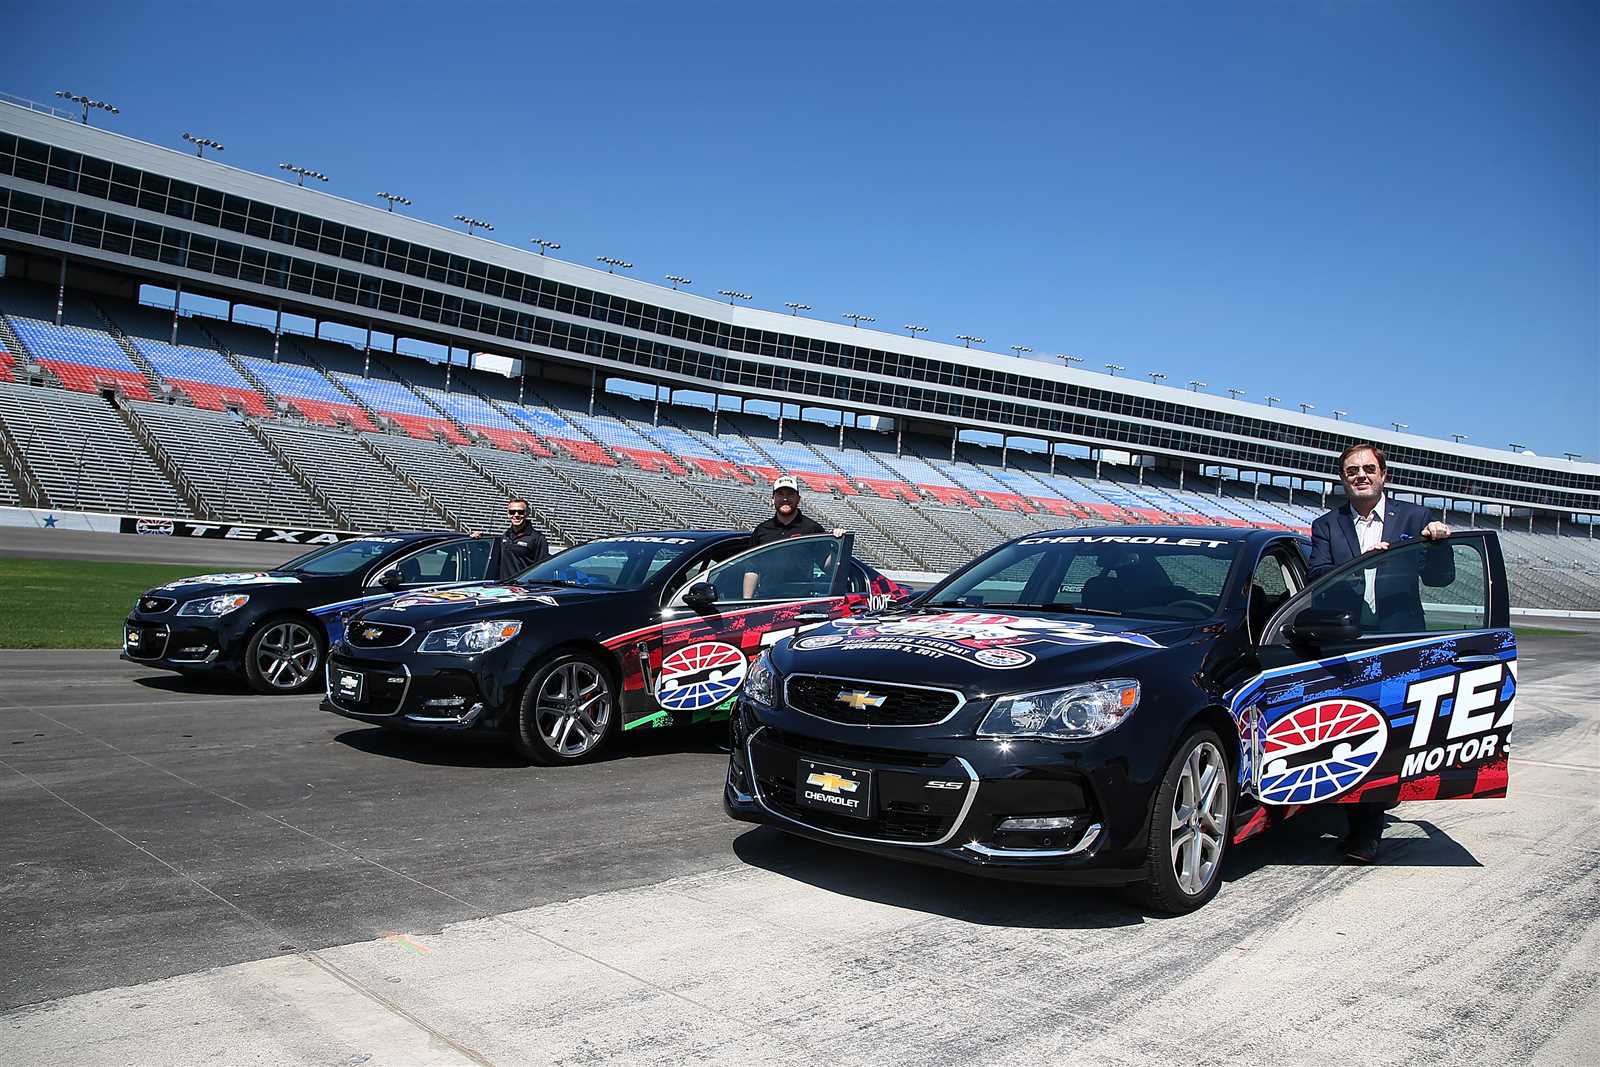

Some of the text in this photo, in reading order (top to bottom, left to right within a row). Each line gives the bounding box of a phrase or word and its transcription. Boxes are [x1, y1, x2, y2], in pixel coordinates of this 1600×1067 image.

[1018, 536, 1228, 548] CHEVROLET
[914, 648, 945, 659] 2017
[915, 639, 971, 655] SPEEDWAY
[1400, 734, 1499, 778] MOTOR
[923, 780, 964, 790] SS
[804, 790, 860, 809] CHEVROLET
